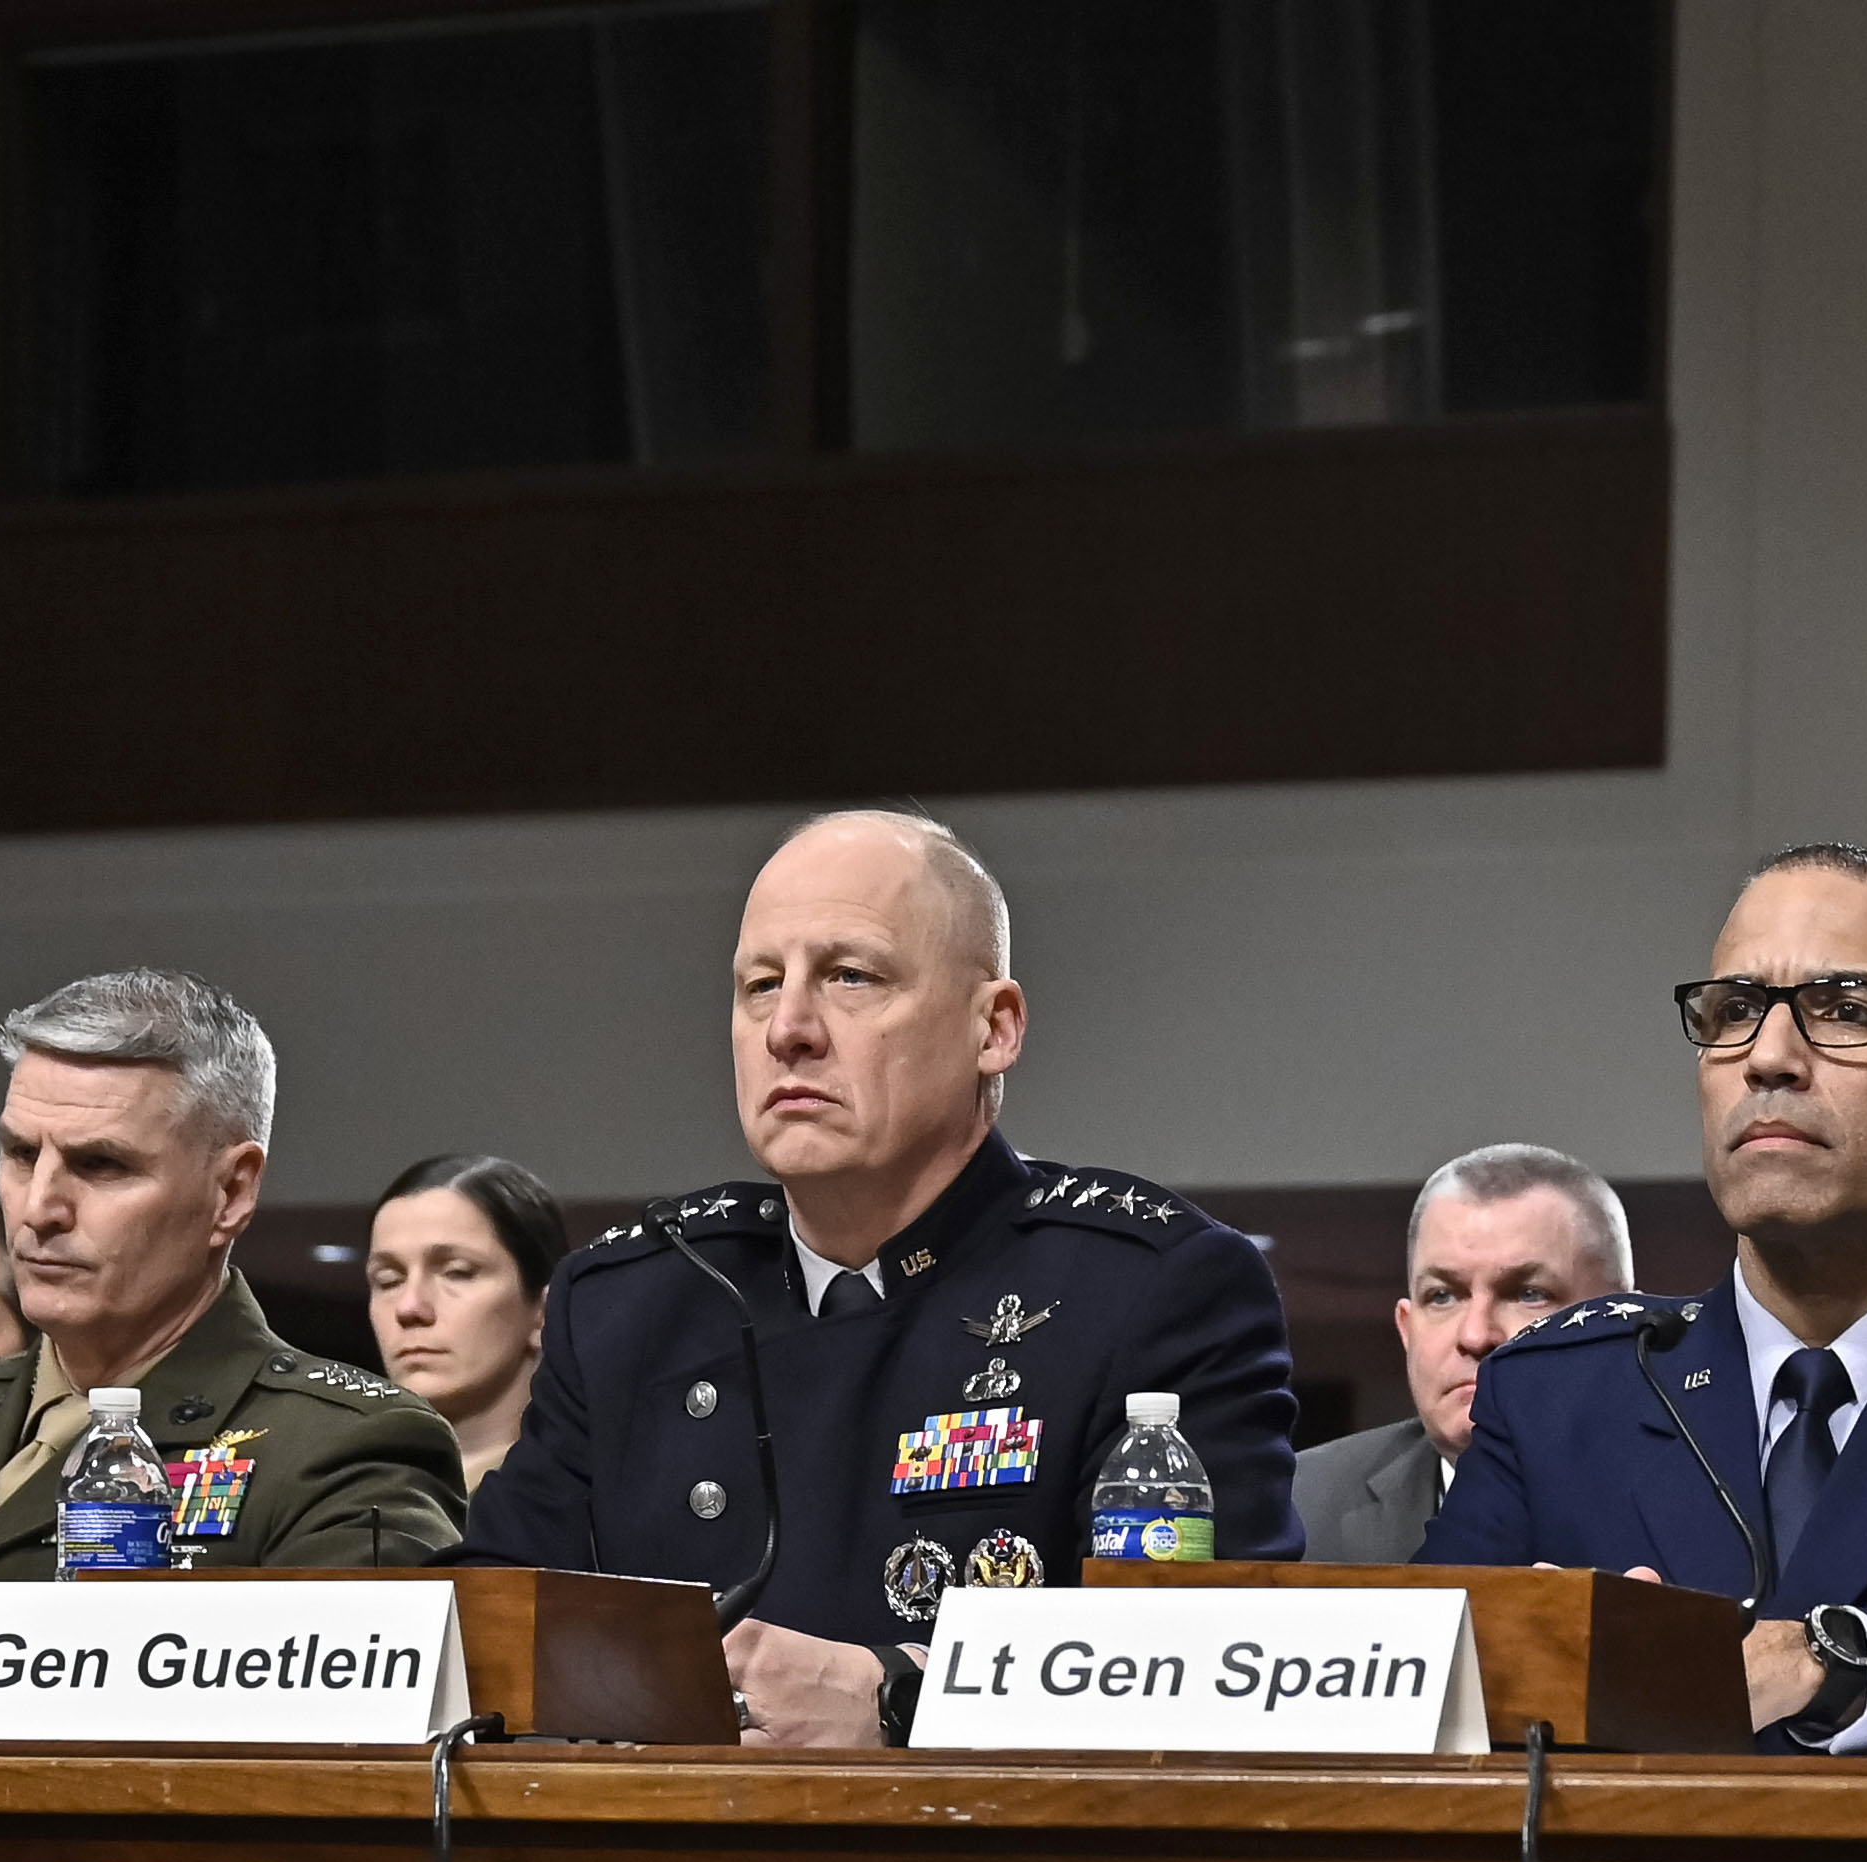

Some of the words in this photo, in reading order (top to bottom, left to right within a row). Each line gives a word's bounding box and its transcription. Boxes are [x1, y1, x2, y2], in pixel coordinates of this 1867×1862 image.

[137, 1632, 421, 1689] Guetlein
[943, 1641, 1015, 1696] Lt
[1040, 1641, 1184, 1697] Gen
[1215, 1642, 1426, 1712] Spain
